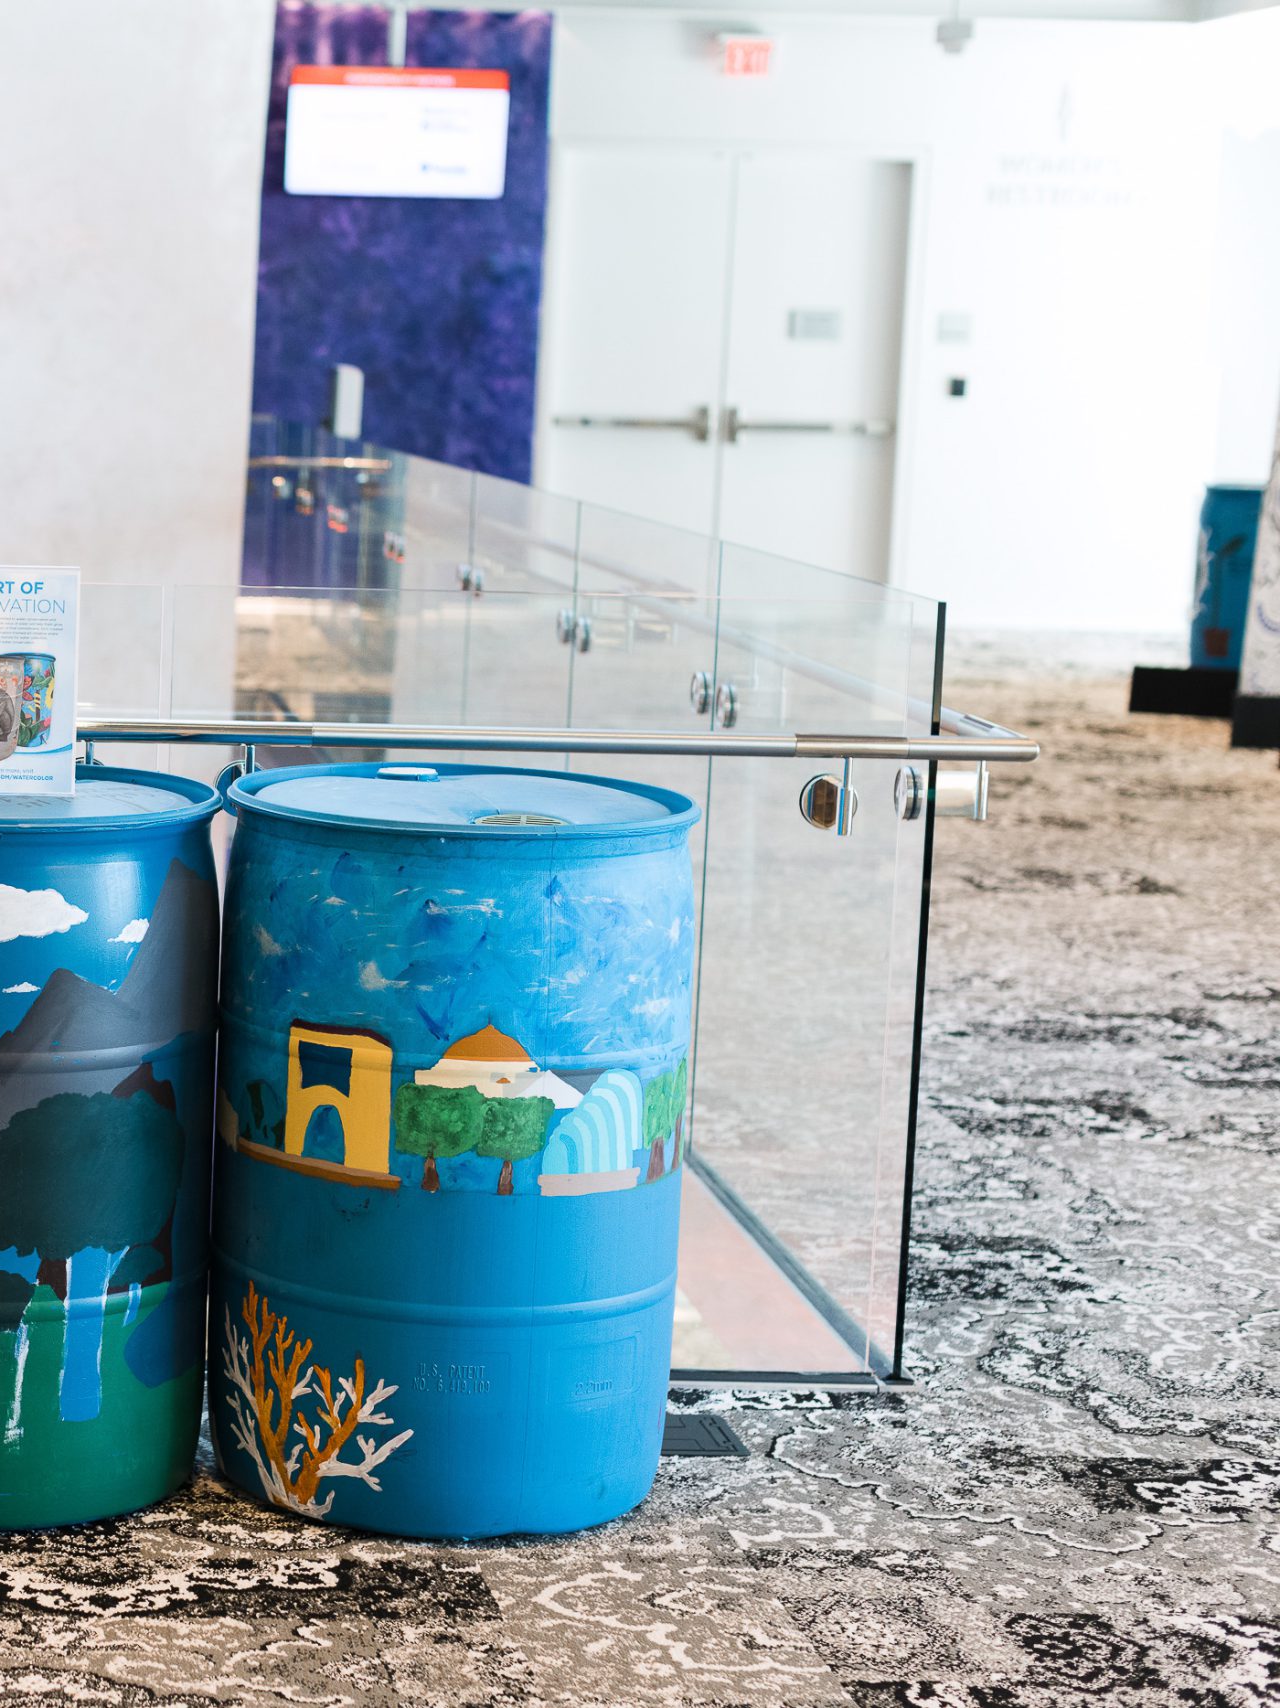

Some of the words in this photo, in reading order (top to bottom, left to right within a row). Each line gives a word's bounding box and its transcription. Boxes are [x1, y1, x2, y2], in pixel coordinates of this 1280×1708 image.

[20, 581, 44, 595] OF
[420, 1362, 442, 1378] U.S.
[449, 1364, 486, 1379] PATENT
[413, 1377, 430, 1392] NO.
